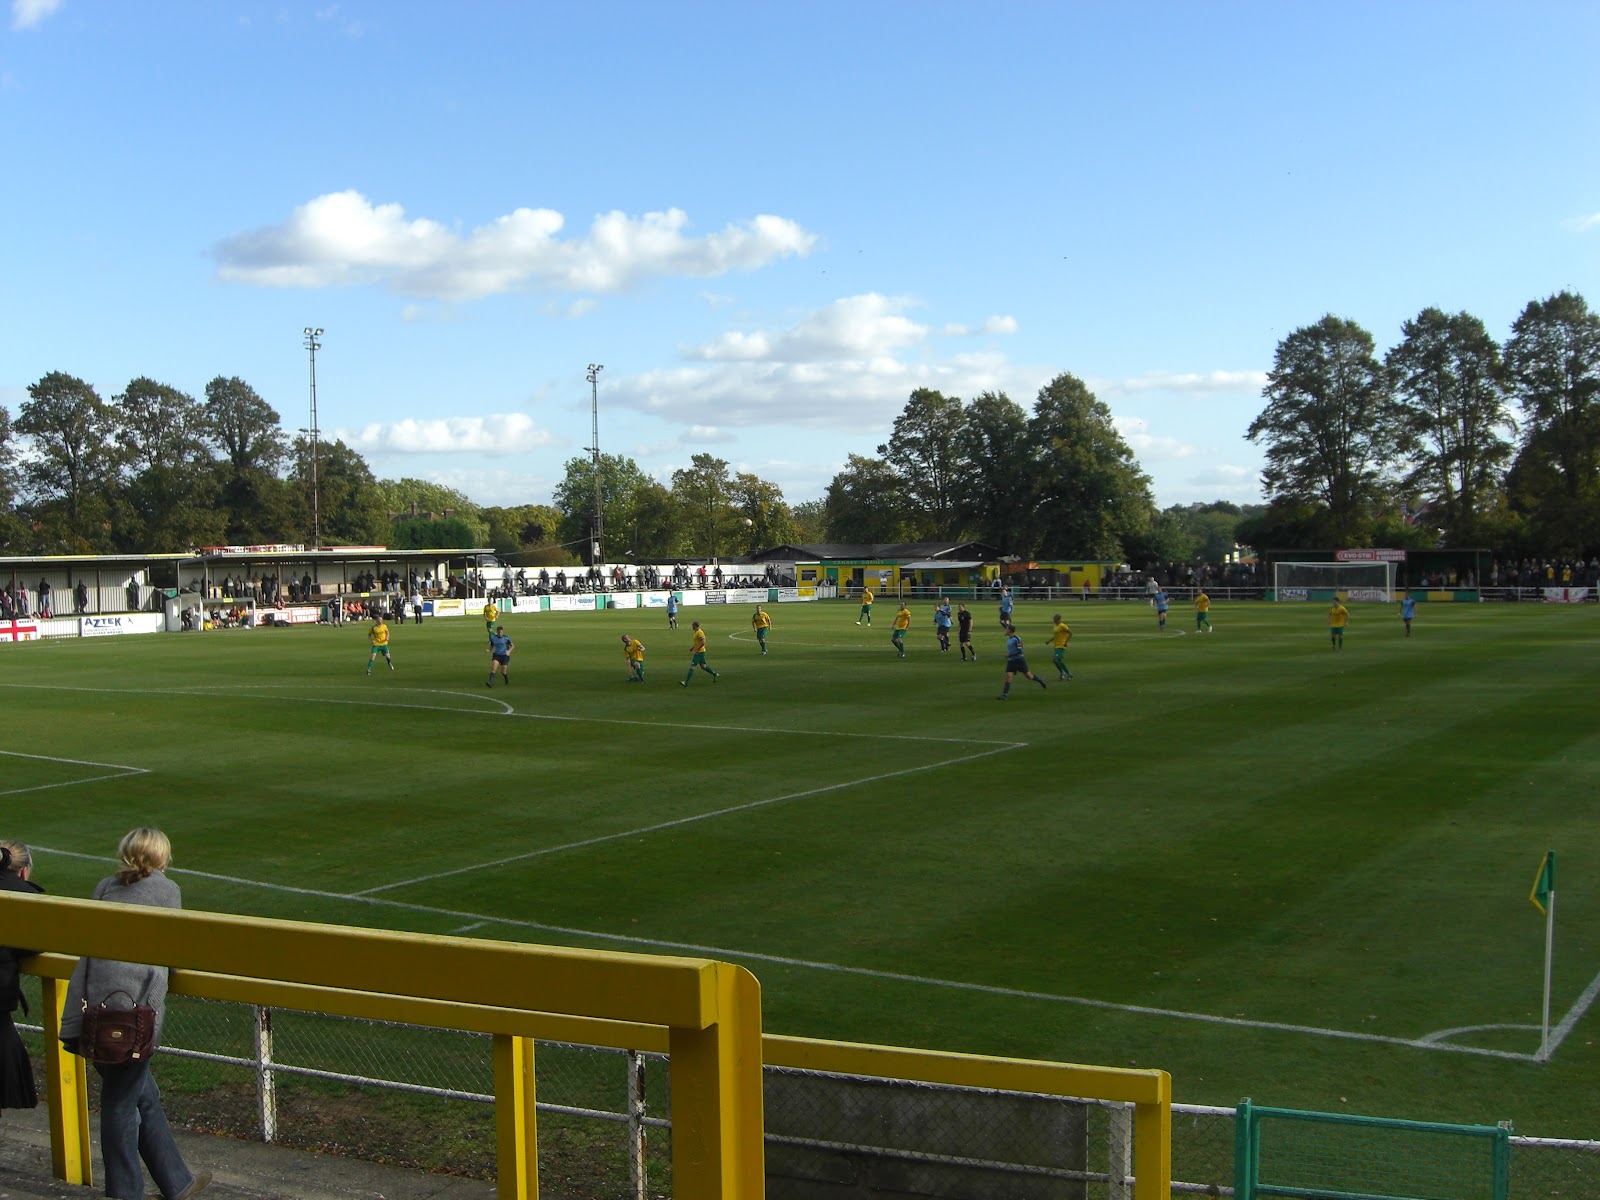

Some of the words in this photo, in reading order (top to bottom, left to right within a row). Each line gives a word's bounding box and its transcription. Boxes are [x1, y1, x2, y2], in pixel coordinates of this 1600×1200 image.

[1280, 588, 1308, 596] AZTEK
[517, 599, 539, 607] ptime
[84, 617, 122, 628] AZTEK
